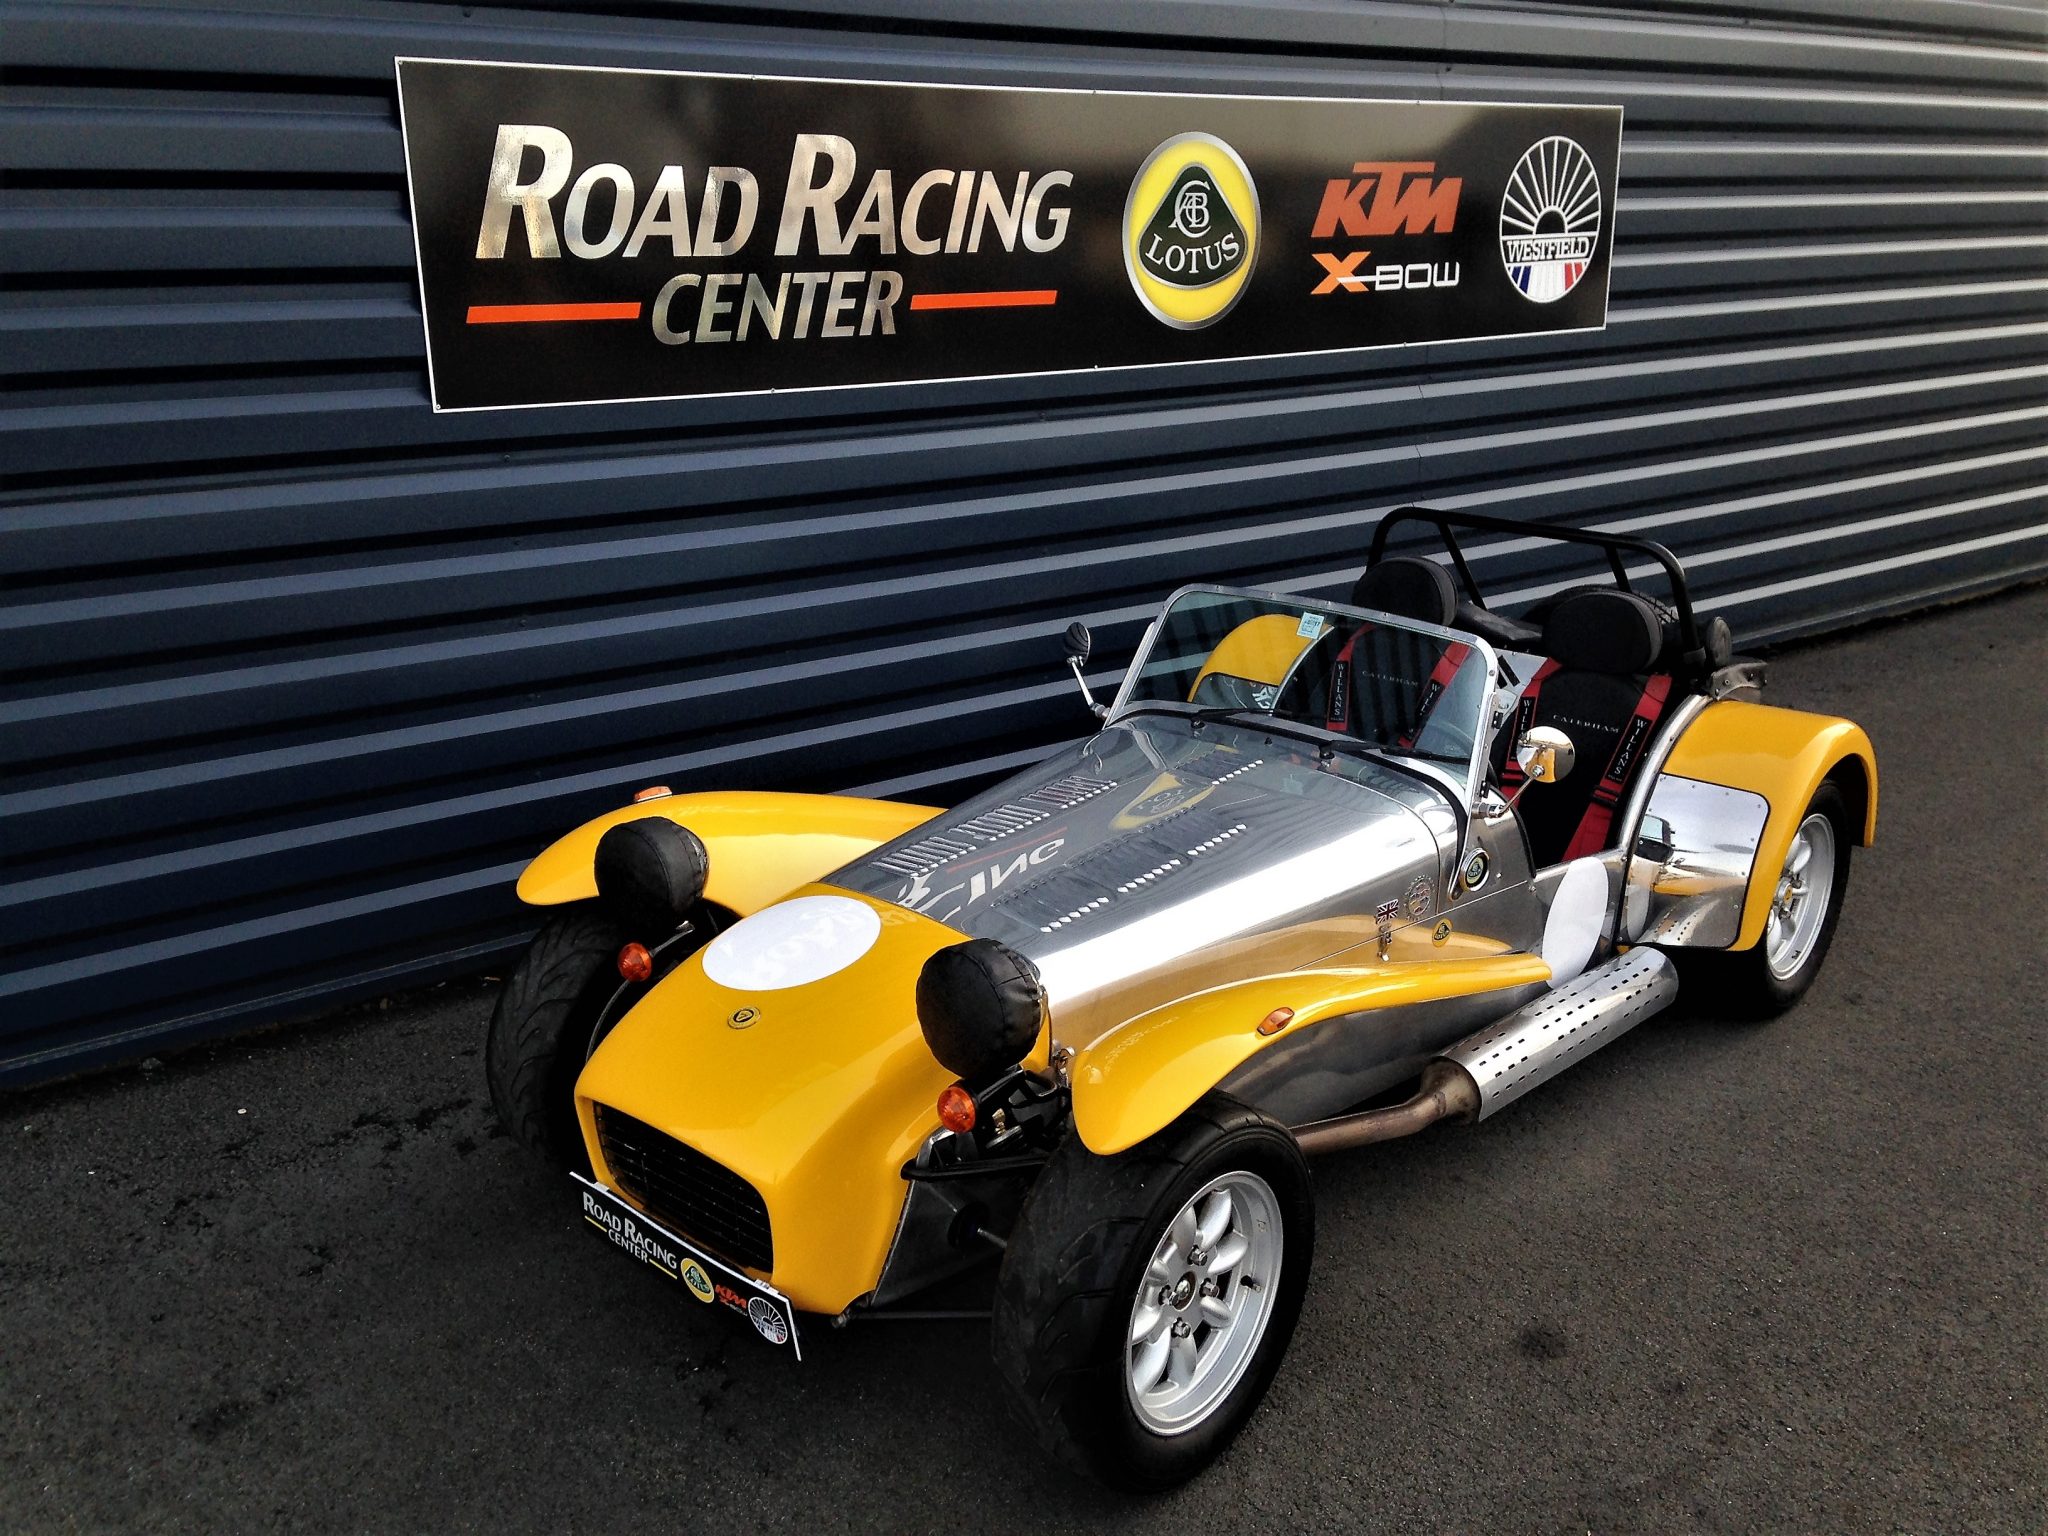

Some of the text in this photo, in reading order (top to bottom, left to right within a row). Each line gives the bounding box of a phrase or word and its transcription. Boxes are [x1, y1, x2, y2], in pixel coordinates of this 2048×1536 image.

[475, 124, 1073, 259] ROAD RACING
[1311, 162, 1463, 238] KTM
[1145, 232, 1241, 274] LOTUS
[1506, 238, 1591, 263] WESTFIELD
[652, 270, 904, 345] CENTER
[1334, 663, 1345, 716] WILLANS
[1552, 713, 1620, 734] CATERHAM
[1614, 718, 1647, 775] WILLANS
[582, 1191, 677, 1270] ROAD RACING
[608, 1228, 648, 1264] CENTER
